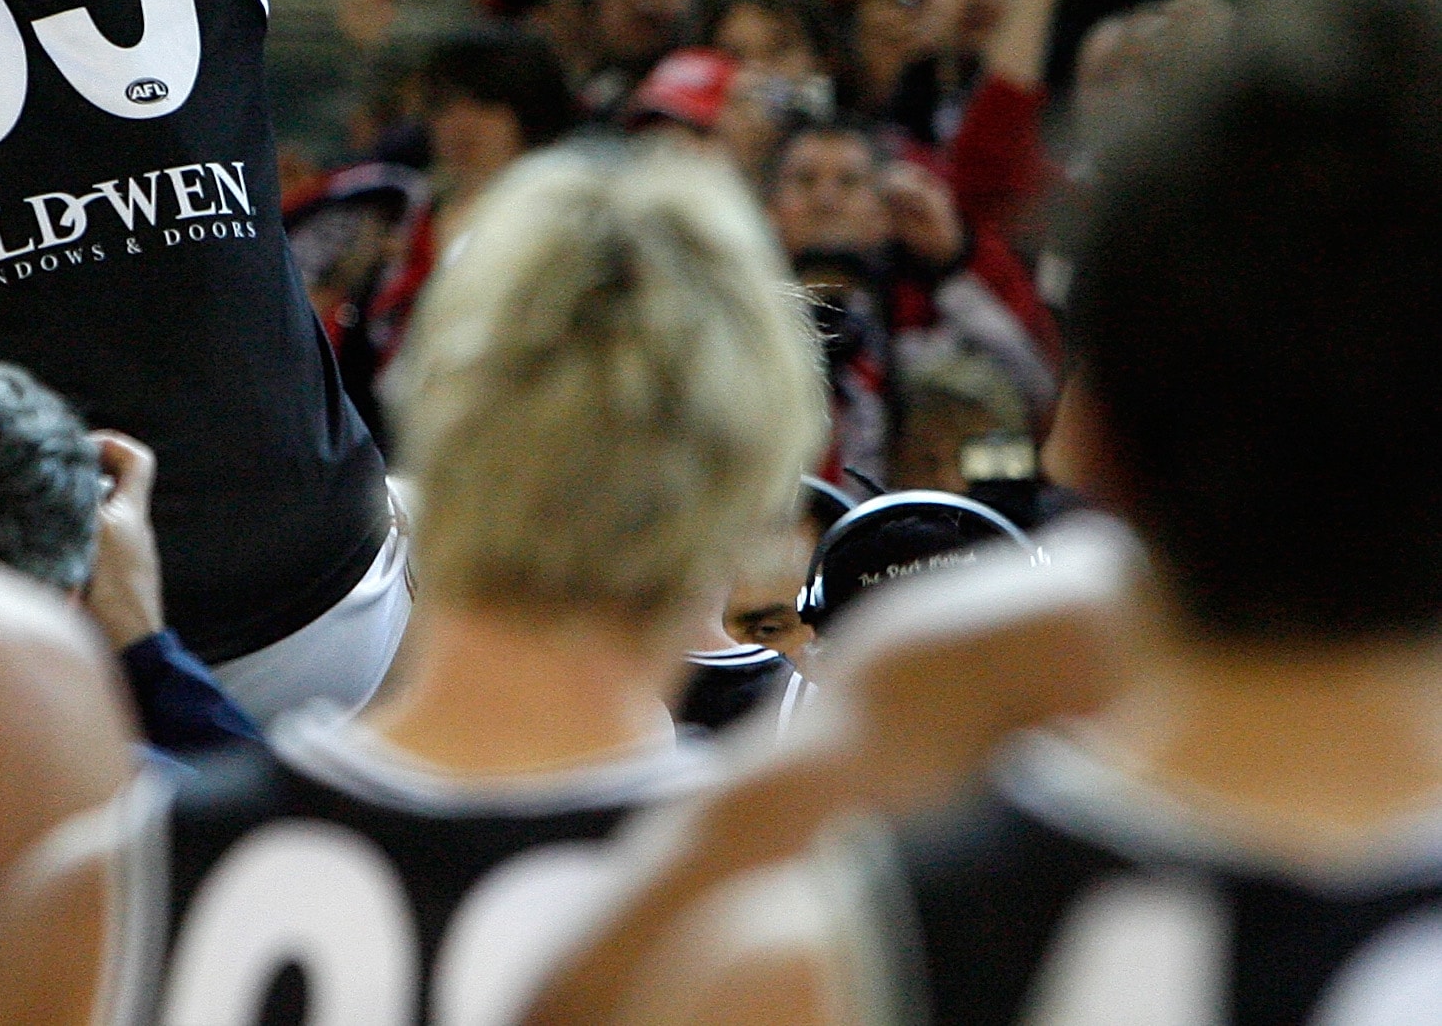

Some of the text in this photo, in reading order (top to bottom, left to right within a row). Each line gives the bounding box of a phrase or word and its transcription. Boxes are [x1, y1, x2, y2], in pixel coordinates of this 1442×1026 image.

[128, 83, 166, 101] AFL
[126, 237, 144, 255] &
[163, 221, 257, 246] DOORS
